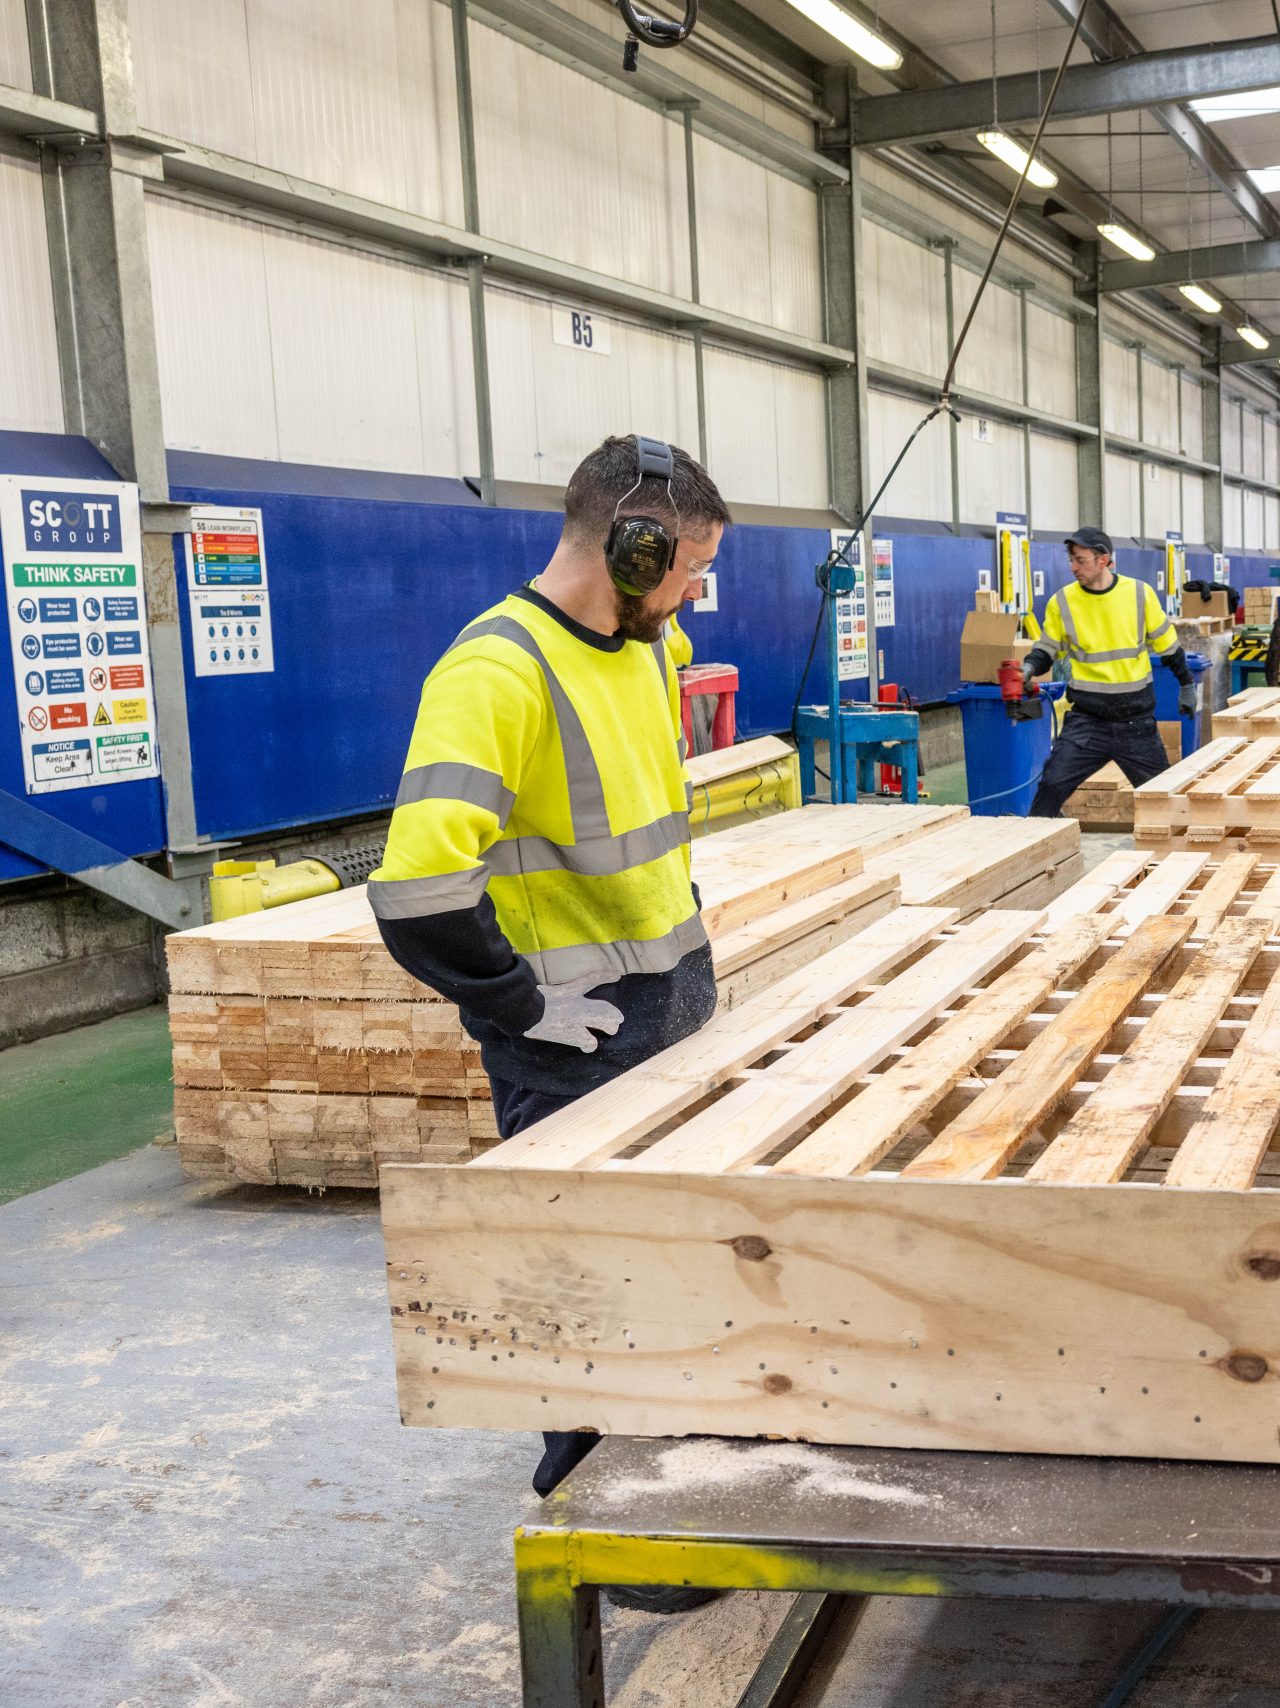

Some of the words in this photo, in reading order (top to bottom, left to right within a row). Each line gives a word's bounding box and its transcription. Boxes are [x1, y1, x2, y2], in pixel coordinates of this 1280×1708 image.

[572, 312, 592, 348] B5
[29, 500, 112, 530] SCOTT
[34, 530, 110, 544] GROUP
[24, 566, 72, 583] THINK
[73, 566, 126, 583] SAFETY
[57, 715, 81, 724] smoking
[102, 736, 126, 745] SAFETY
[126, 734, 143, 743] FIRST
[48, 742, 75, 752] NOTICE
[45, 756, 62, 764] Keep
[54, 765, 74, 774] Clean
